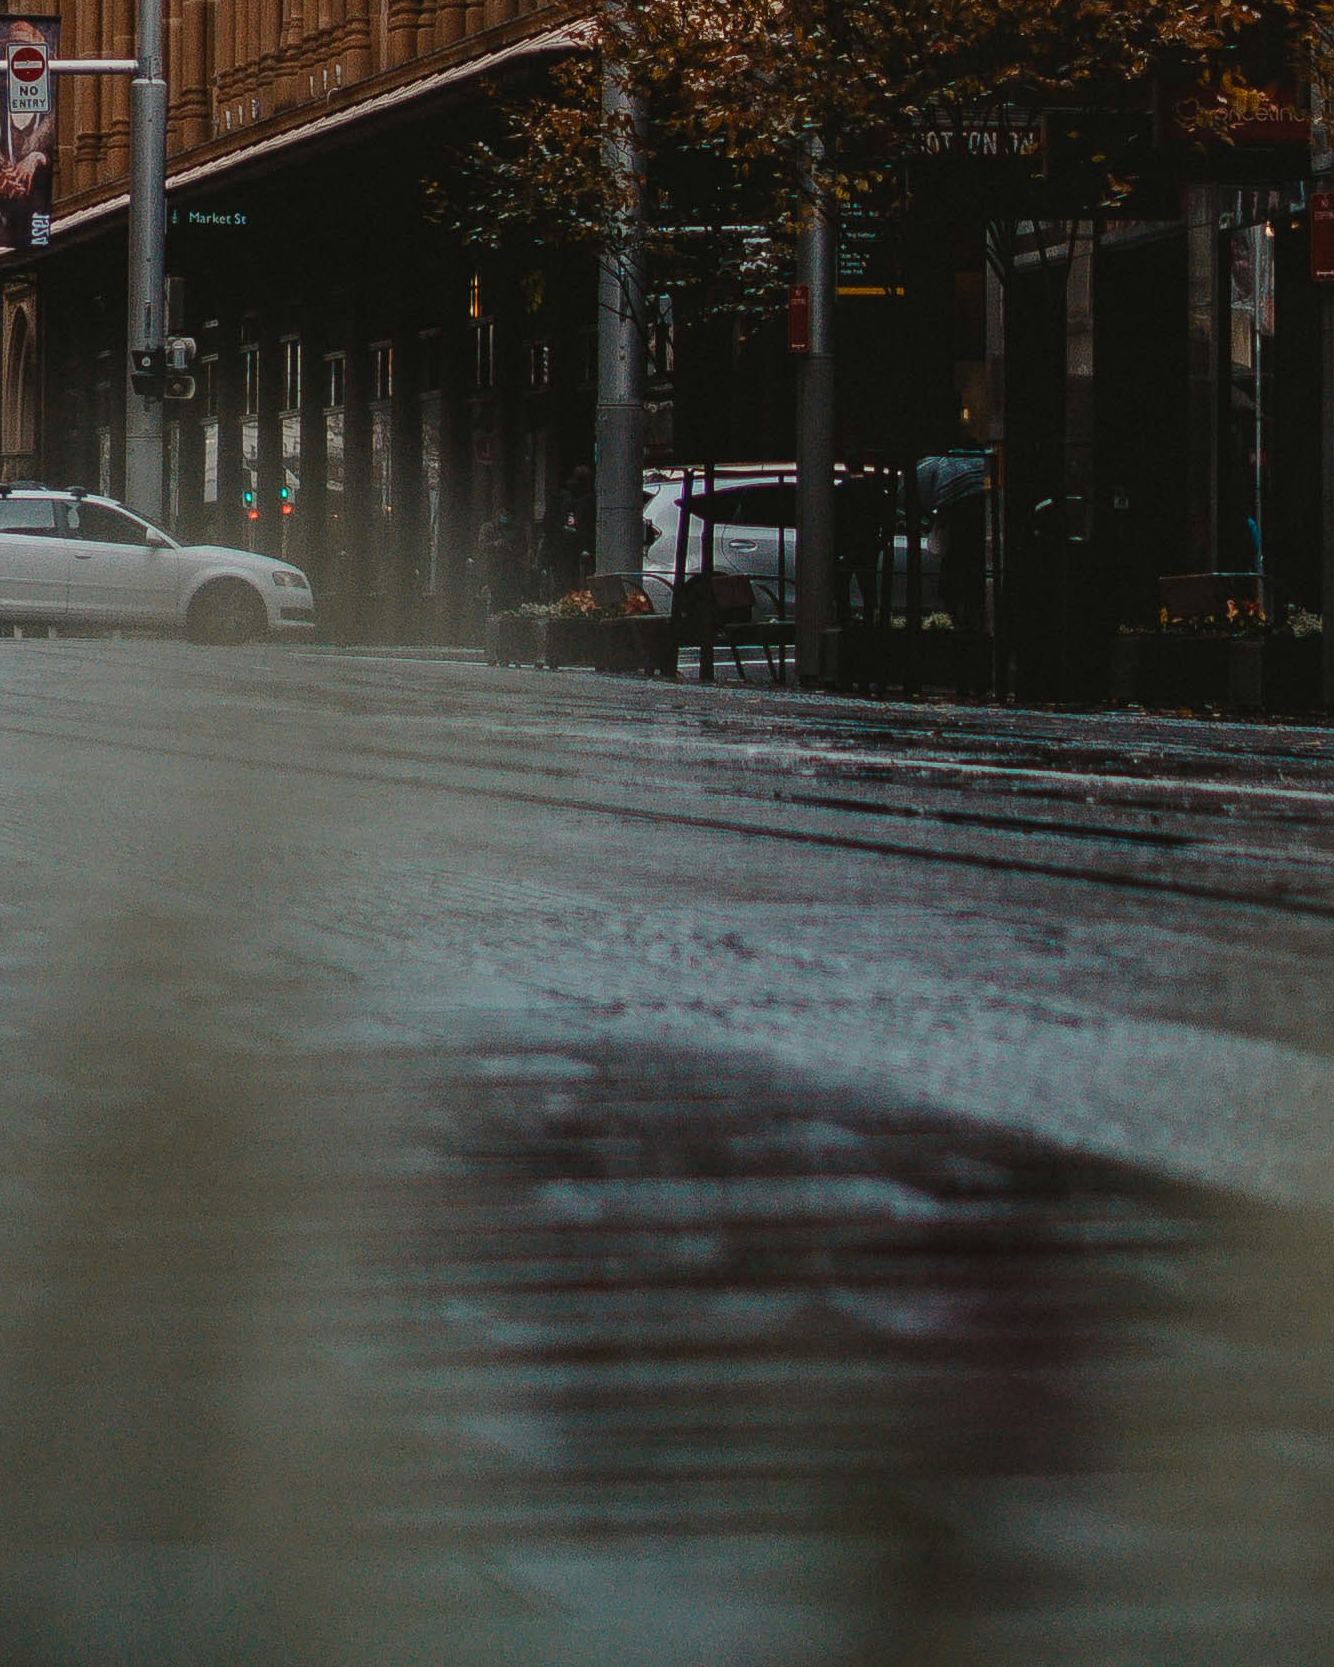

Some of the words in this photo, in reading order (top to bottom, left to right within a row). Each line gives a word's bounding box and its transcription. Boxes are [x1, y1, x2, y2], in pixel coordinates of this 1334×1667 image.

[19, 85, 39, 96] NO
[12, 98, 46, 109] ENTRY
[188, 210, 232, 225] Market
[234, 211, 248, 225] St
